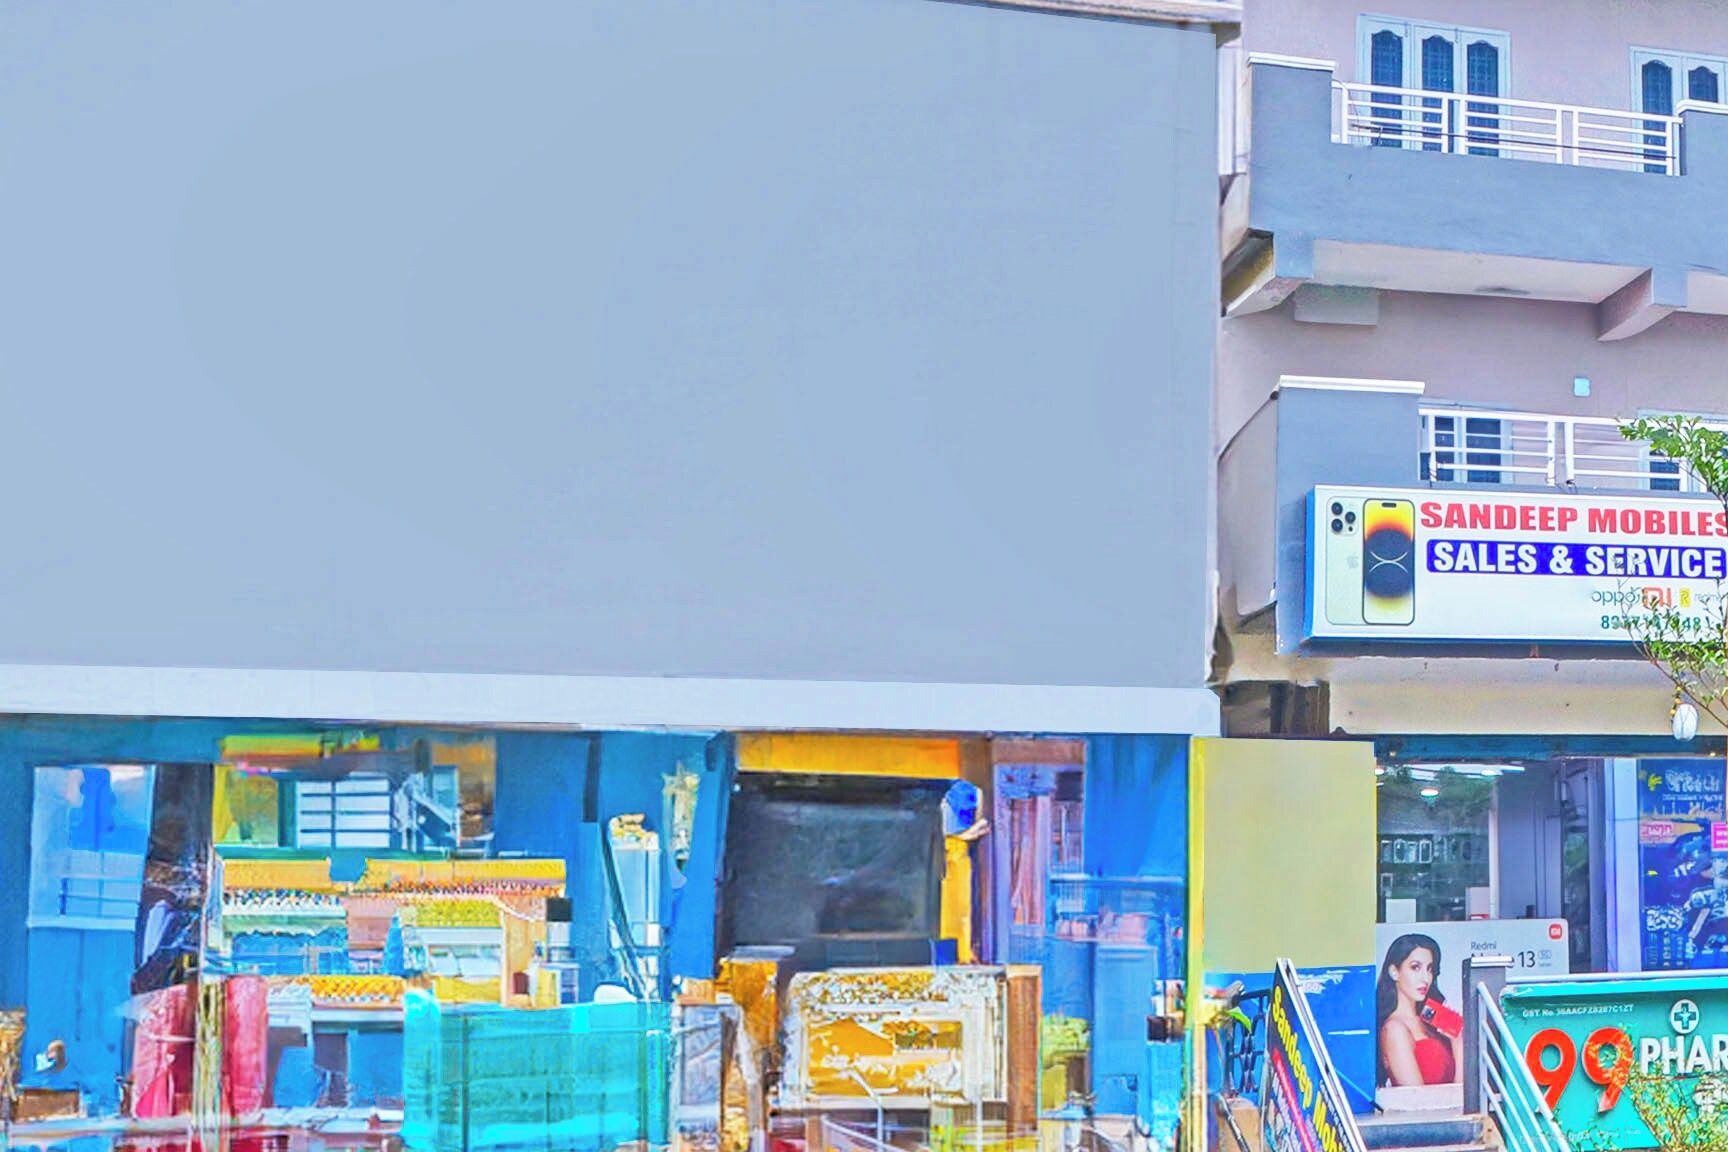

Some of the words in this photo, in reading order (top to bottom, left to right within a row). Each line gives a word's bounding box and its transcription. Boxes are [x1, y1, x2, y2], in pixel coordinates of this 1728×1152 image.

[1421, 501, 1578, 532] SANDEEP
[1433, 541, 1537, 574] SALES
[1550, 545, 1574, 575] &
[1585, 546, 1723, 578] SERVICE
[1470, 941, 1497, 950] Redmi
[1518, 950, 1536, 968] 13
[1272, 986, 1313, 1110] Sandeep
[1525, 1026, 1634, 1114] 99
